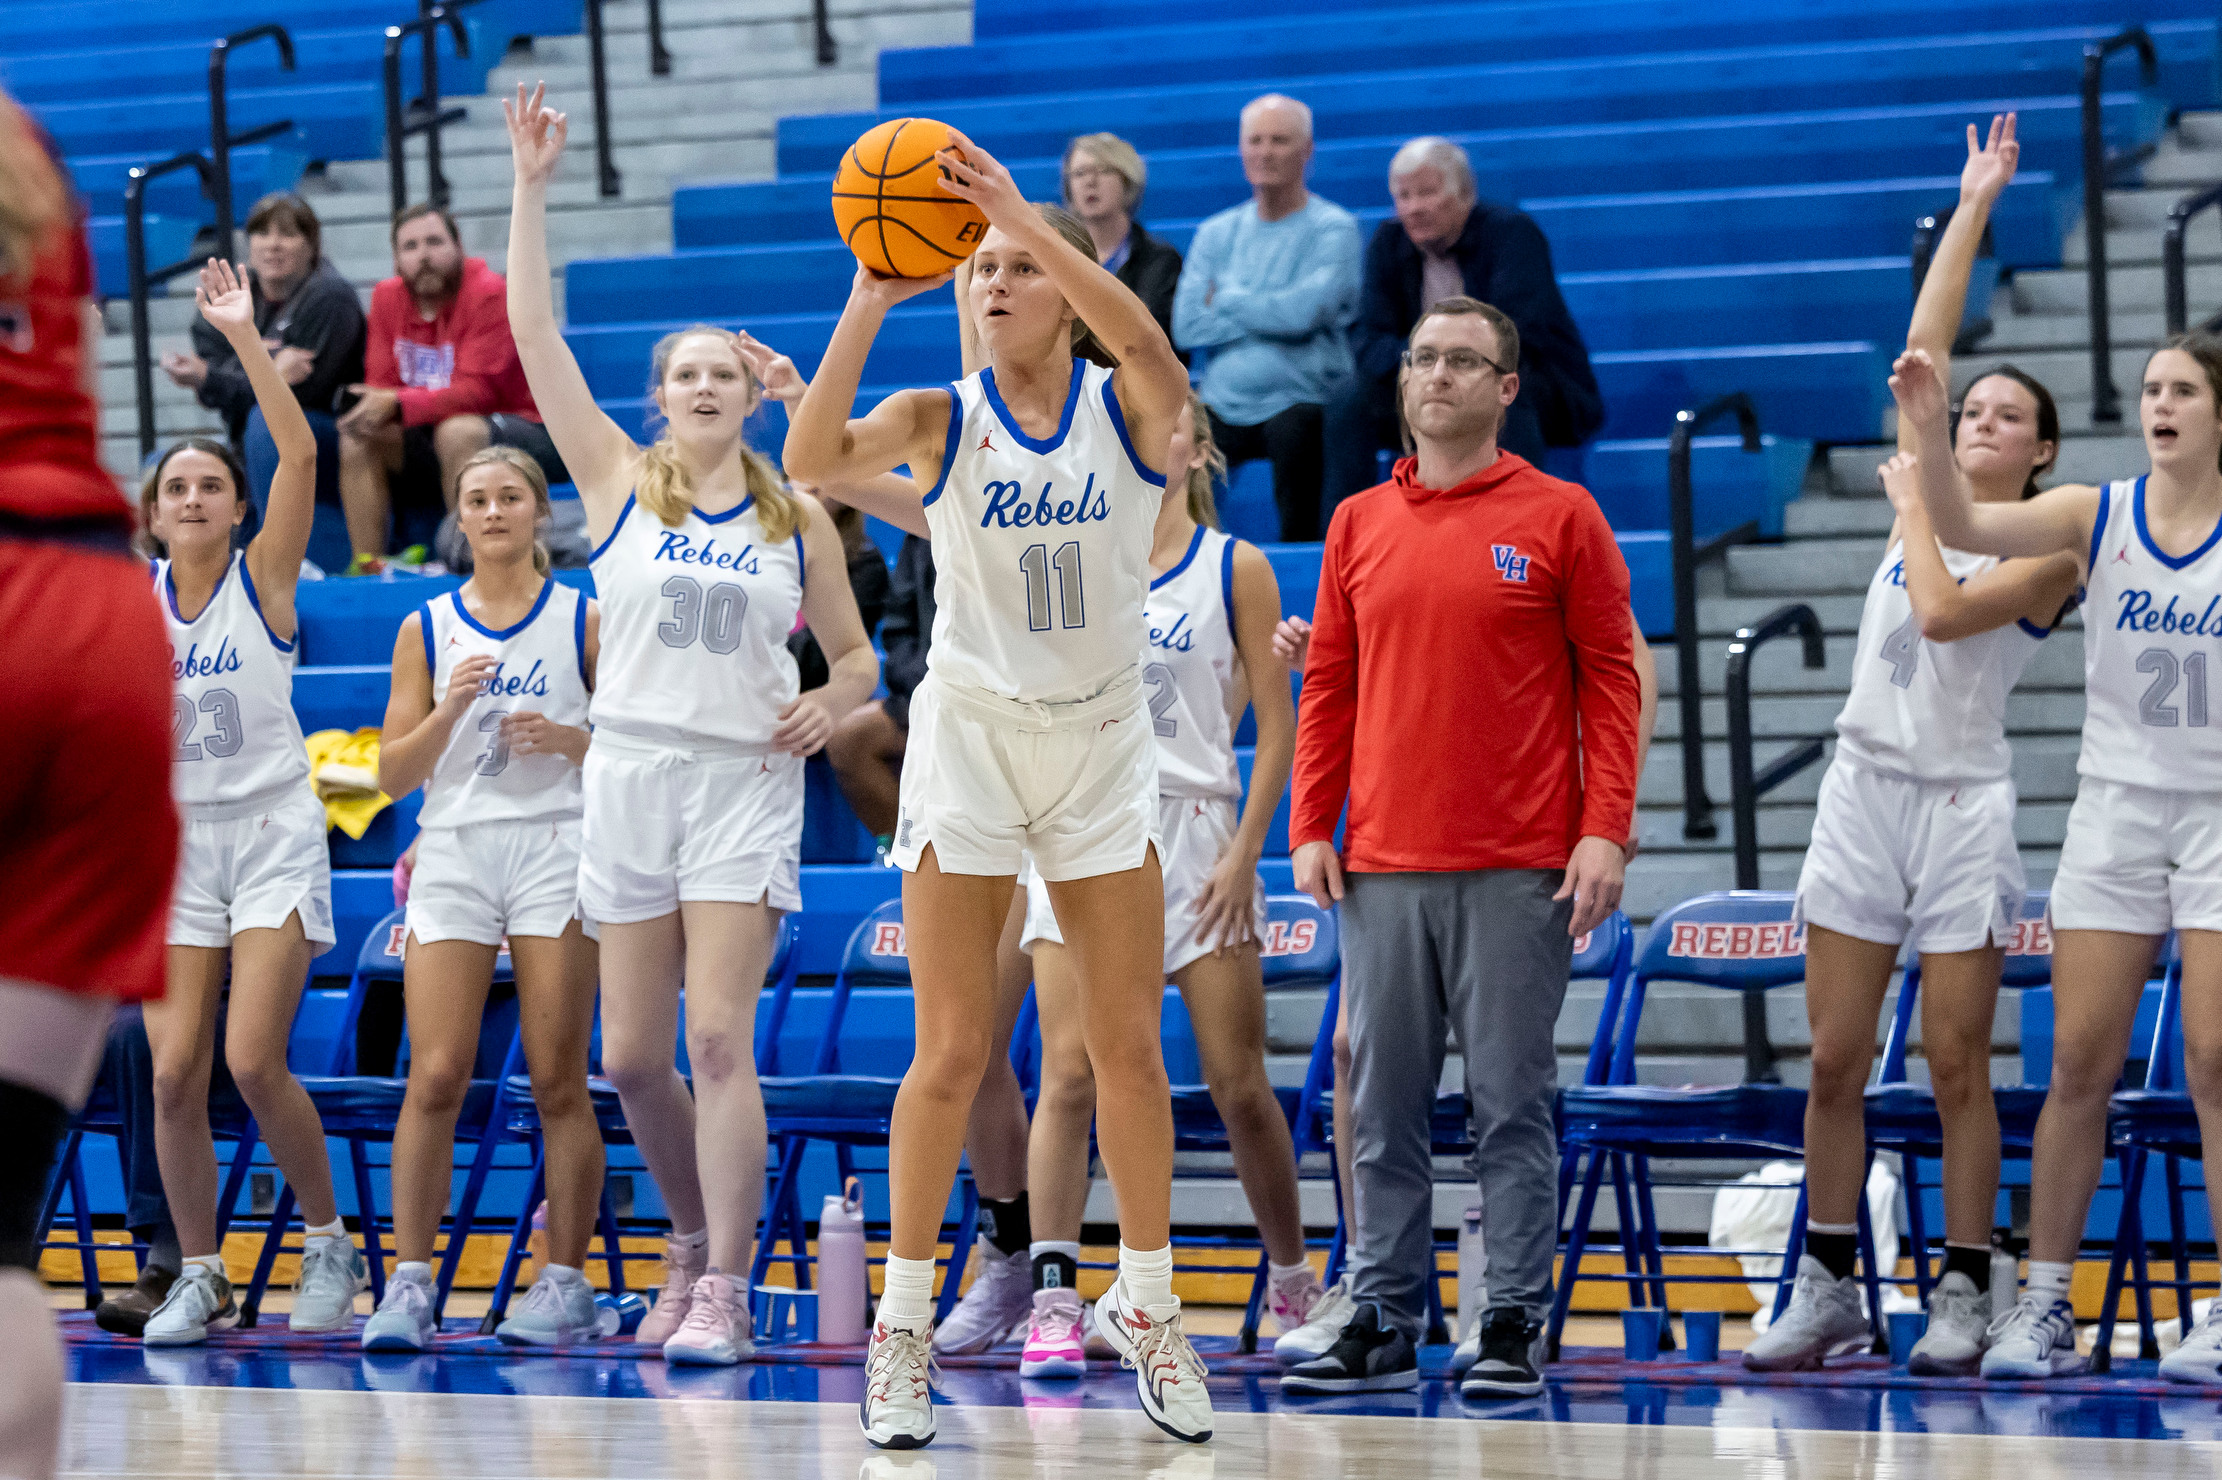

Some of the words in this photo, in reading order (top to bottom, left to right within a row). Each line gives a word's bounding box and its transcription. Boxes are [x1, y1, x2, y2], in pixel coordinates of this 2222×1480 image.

[980, 472, 1112, 528] Rebels
[654, 530, 762, 575] Rebels
[1491, 545, 1531, 583] VH
[1019, 541, 1086, 632] 11
[658, 575, 748, 655] 30
[1143, 612, 1196, 653] els
[173, 634, 244, 681] ebels
[476, 659, 551, 698] bels
[2135, 647, 2208, 728] 21
[171, 687, 244, 762] 23
[1667, 920, 1808, 960] REBEL
